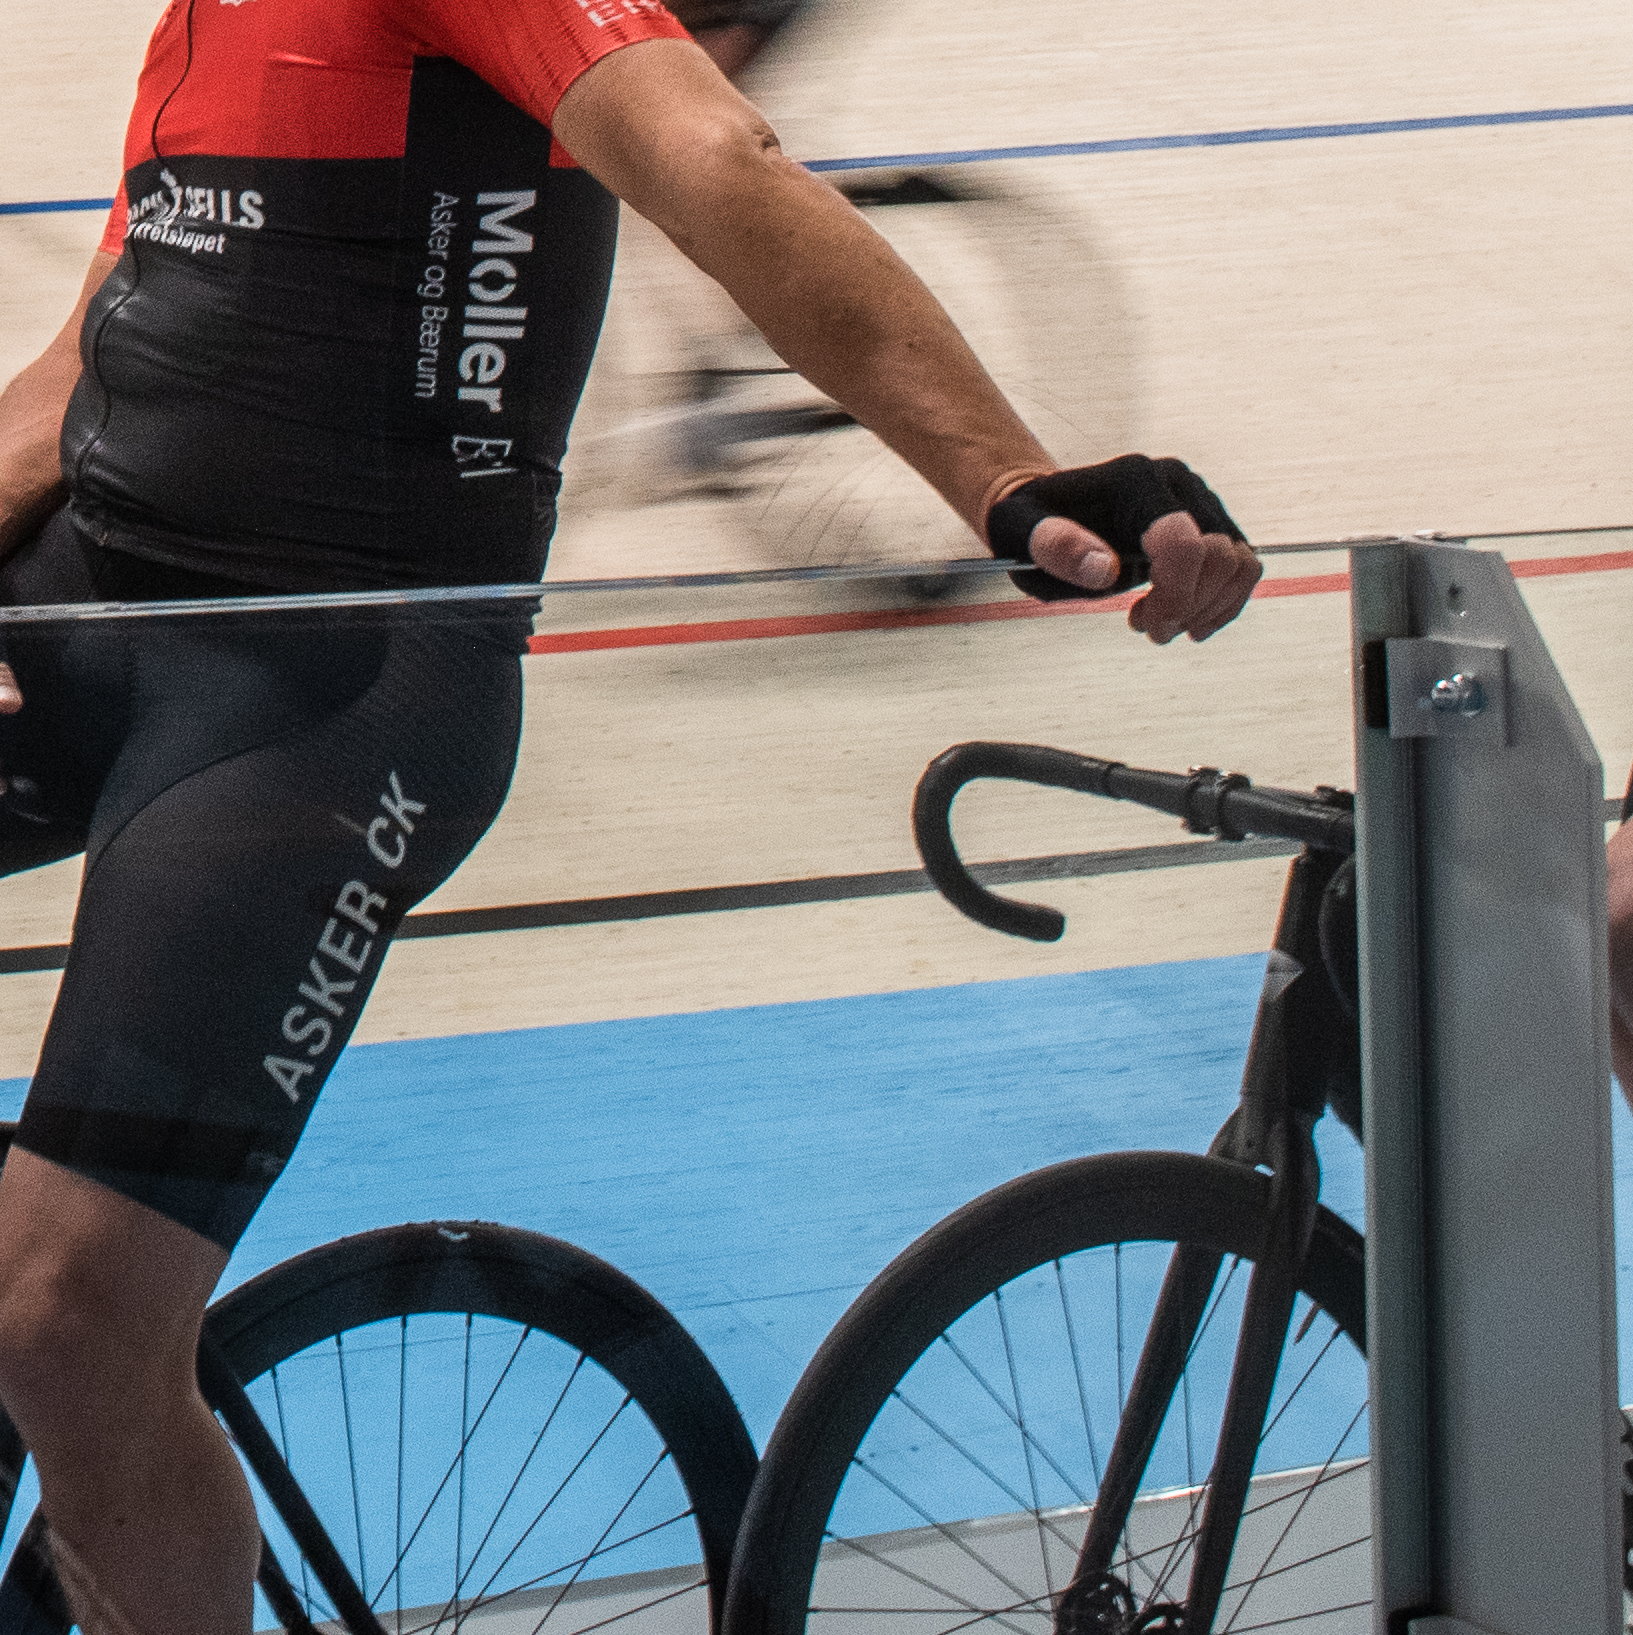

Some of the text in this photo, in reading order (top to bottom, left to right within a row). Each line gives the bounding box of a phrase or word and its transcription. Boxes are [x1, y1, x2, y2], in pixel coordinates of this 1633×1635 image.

[414, 190, 461, 400] Asker og Bærum
[263, 769, 428, 1104] ASKER CK
